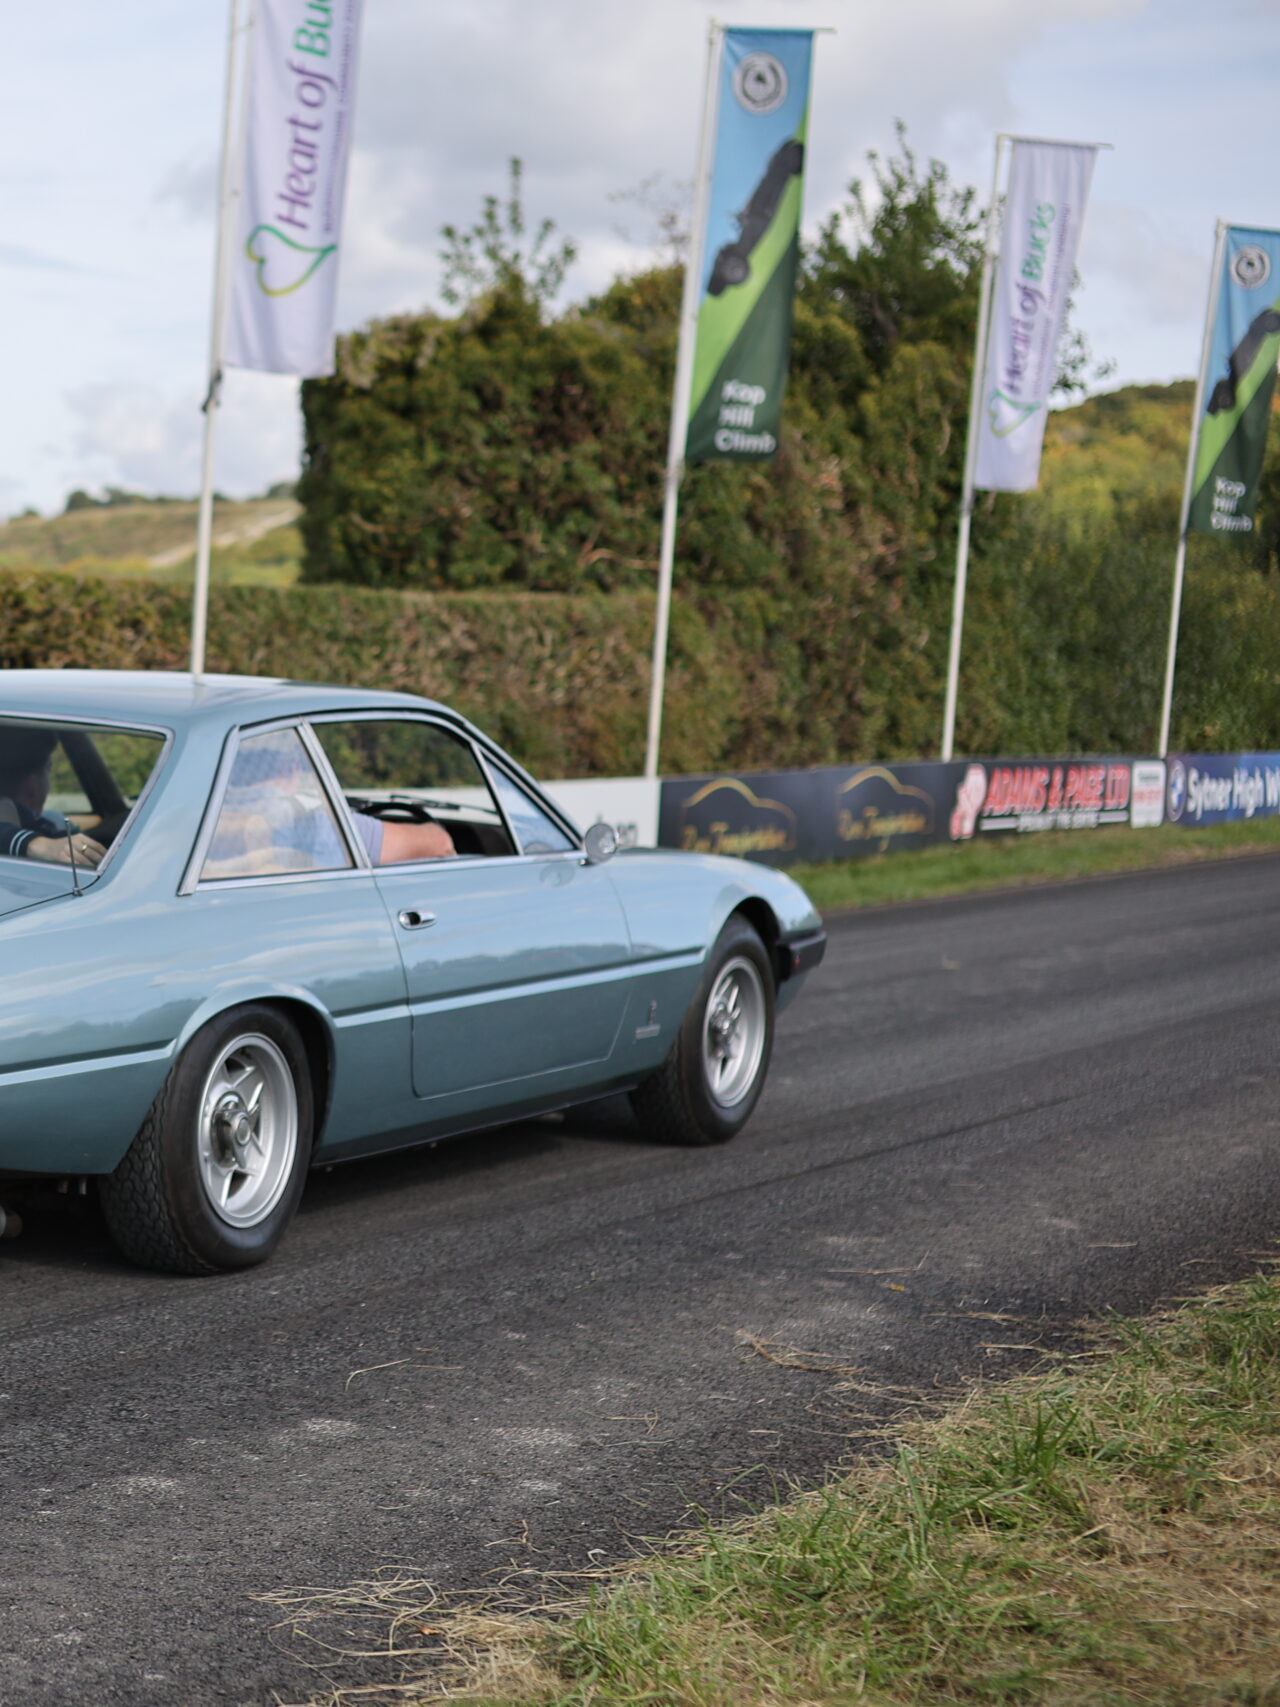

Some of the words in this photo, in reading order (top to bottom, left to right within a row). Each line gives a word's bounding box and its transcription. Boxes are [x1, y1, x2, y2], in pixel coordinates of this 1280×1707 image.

[292, 0, 334, 58] Bu
[285, 58, 338, 108] of
[275, 116, 324, 230] Heart
[1021, 203, 1057, 281] Bucks
[1016, 283, 1047, 316] of
[722, 379, 766, 405] Kop
[719, 404, 754, 428] Hill
[714, 428, 776, 453] Climb
[1216, 476, 1246, 497] Kop
[1213, 495, 1237, 513] Hill
[1211, 513, 1253, 532] Climb
